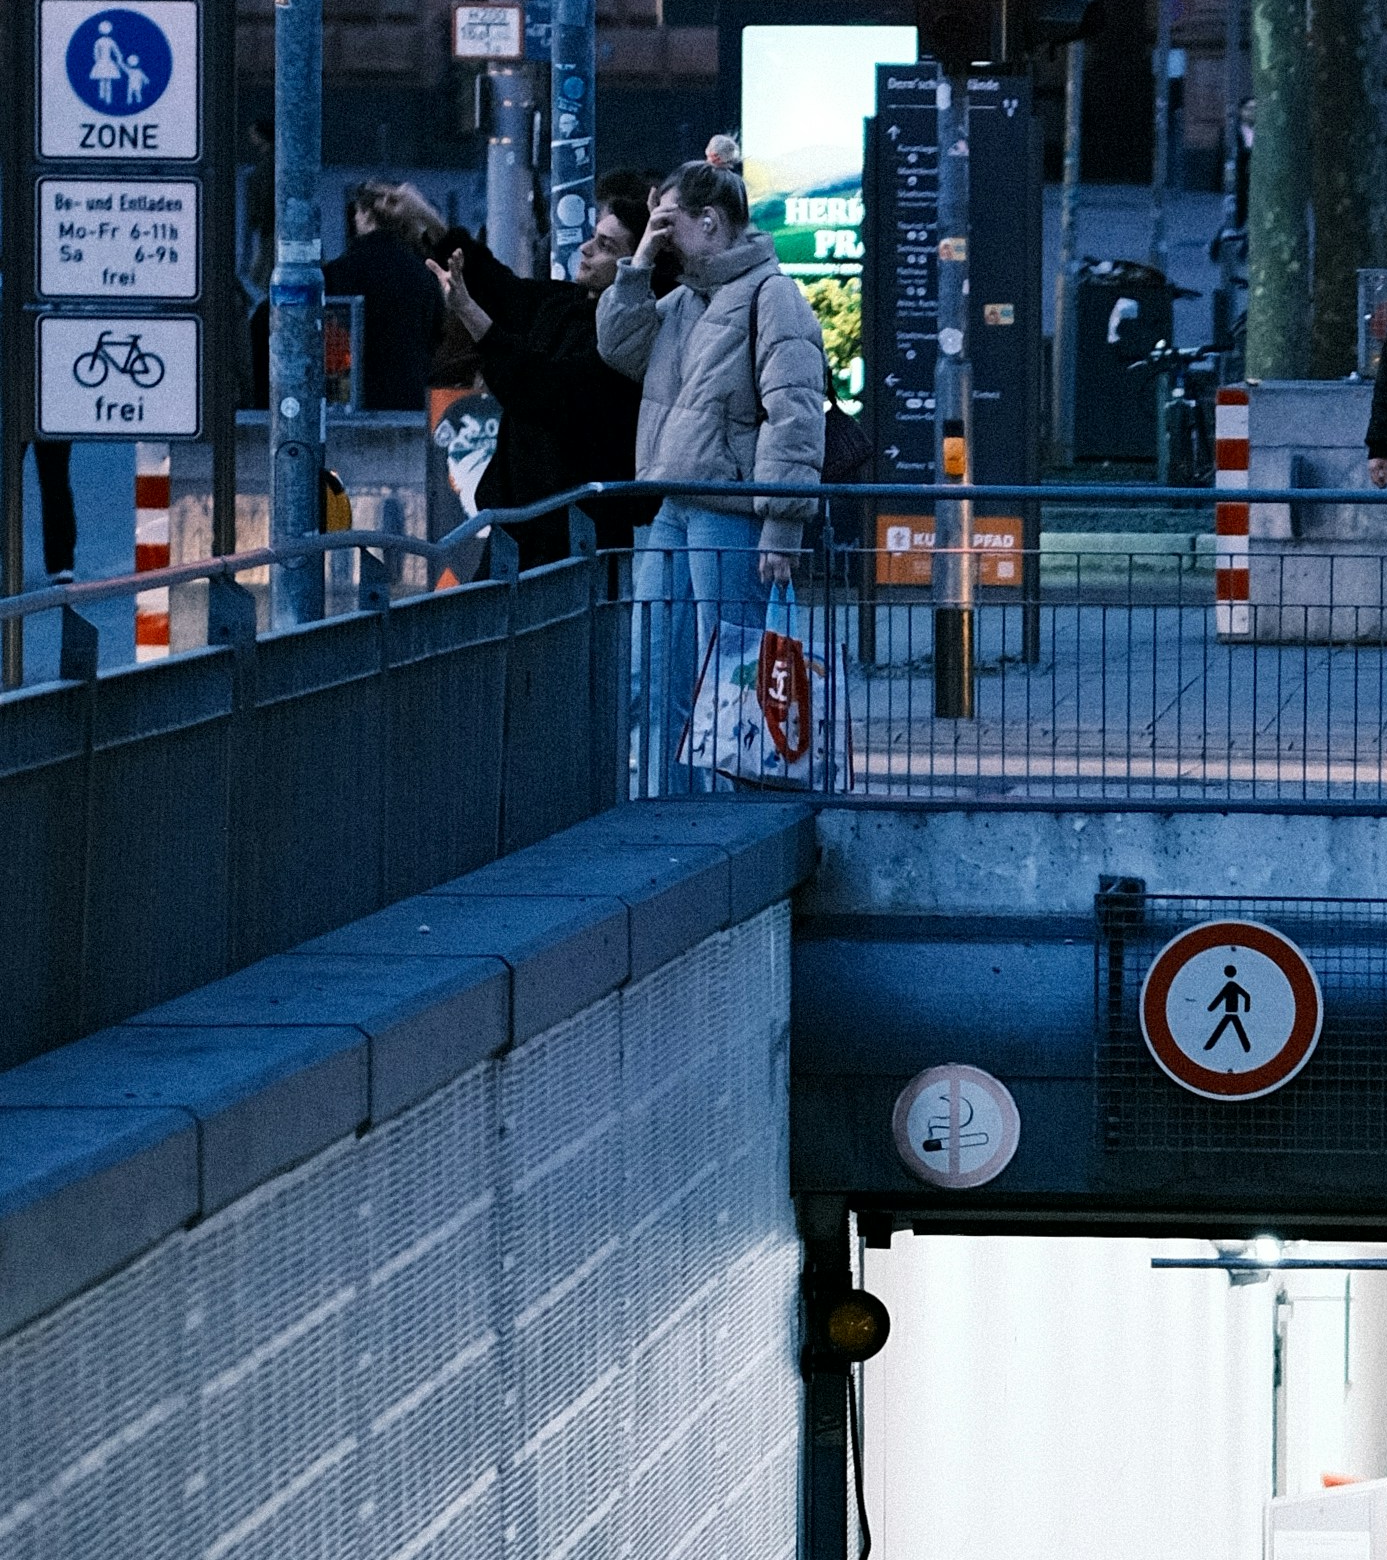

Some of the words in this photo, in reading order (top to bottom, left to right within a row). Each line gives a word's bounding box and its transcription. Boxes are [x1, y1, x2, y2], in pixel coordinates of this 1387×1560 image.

[80, 124, 159, 150] ZONE
[86, 193, 113, 211] und
[119, 192, 183, 212] Entladen
[58, 221, 121, 240] Mo-Fr
[59, 244, 84, 263] Sa
[102, 266, 136, 286] frei
[95, 395, 144, 422] frei
